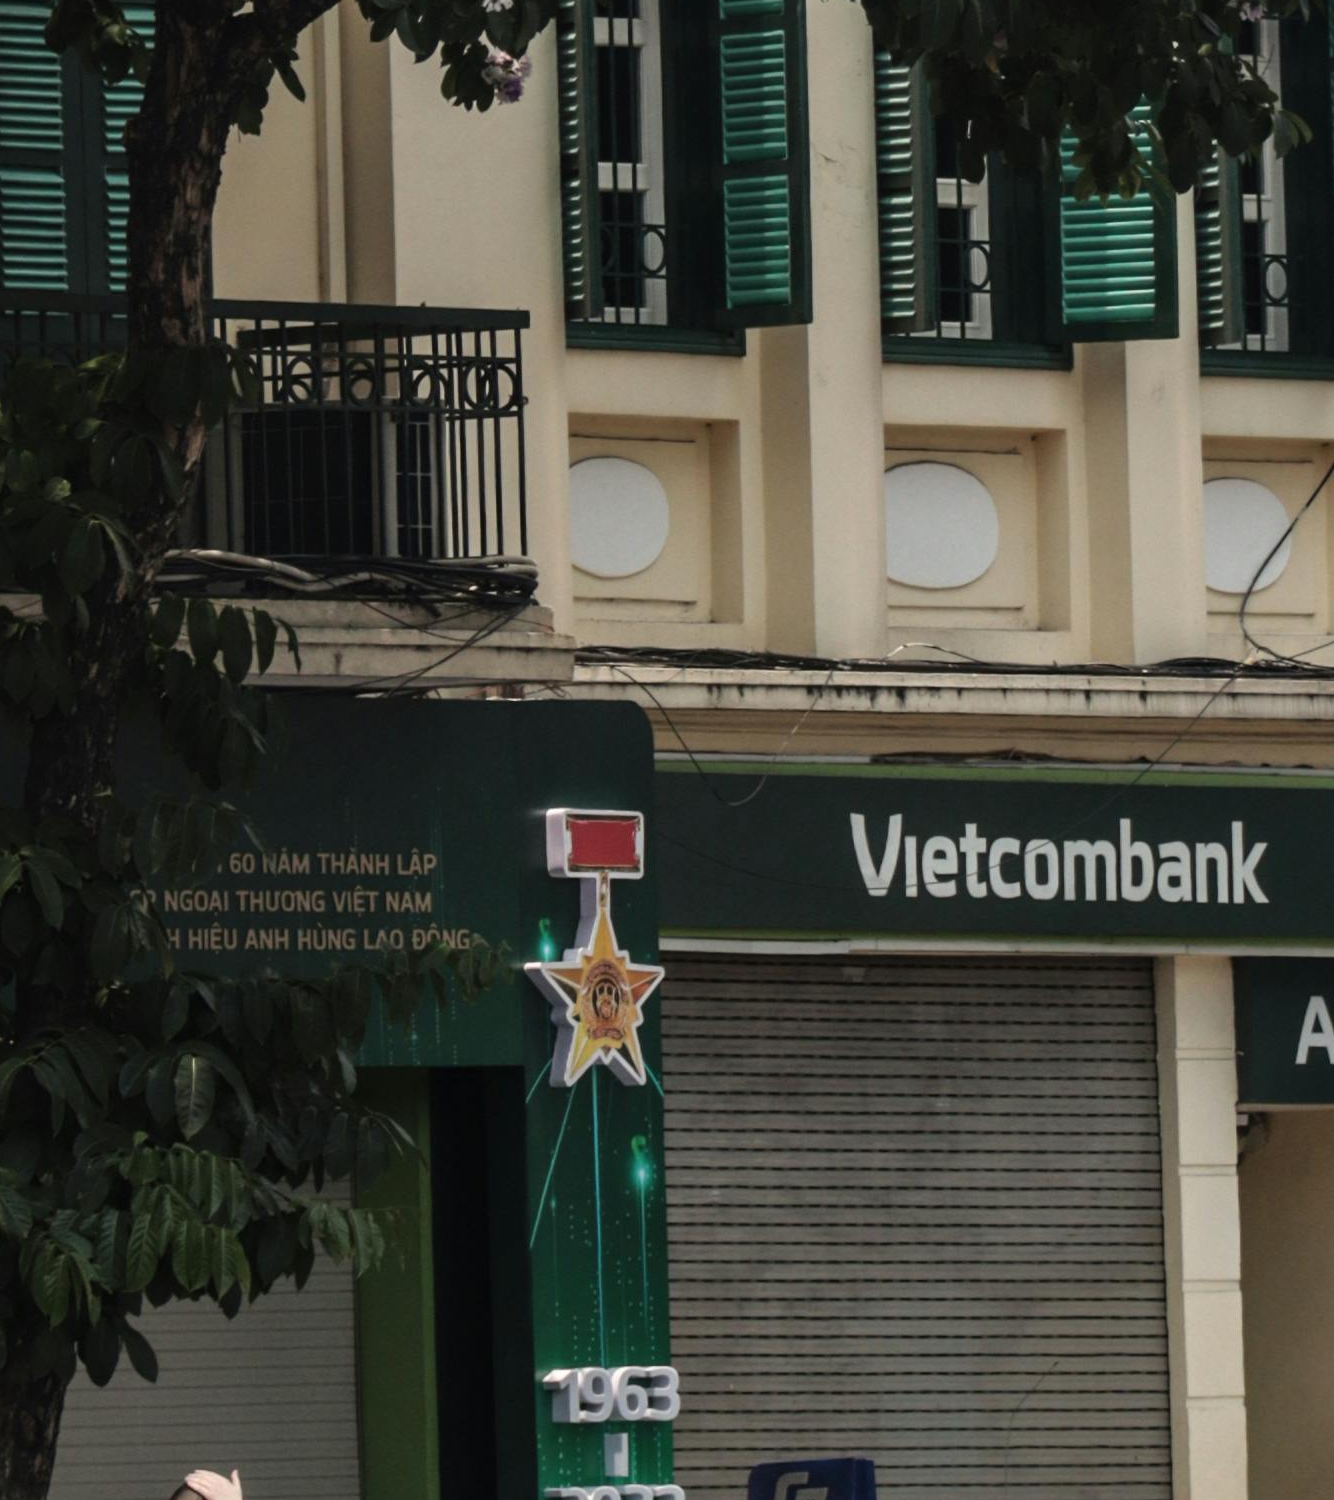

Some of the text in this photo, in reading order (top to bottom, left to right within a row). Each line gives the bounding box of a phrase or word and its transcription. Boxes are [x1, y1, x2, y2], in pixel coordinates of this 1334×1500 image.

[229, 853, 255, 875] 60
[317, 848, 390, 876] THÀNH
[396, 848, 438, 880] LẬP
[850, 813, 1270, 904] Vietcombank
[164, 889, 230, 917] NGOẠI
[235, 889, 325, 914] THƯƠNG
[332, 884, 379, 918] VIỆT
[385, 890, 432, 914] NAM
[188, 922, 238, 955] HIỆU
[244, 928, 290, 950] ANH
[297, 922, 356, 951] HÙNG
[364, 929, 404, 951] LAO
[542, 1366, 681, 1423] 1963
